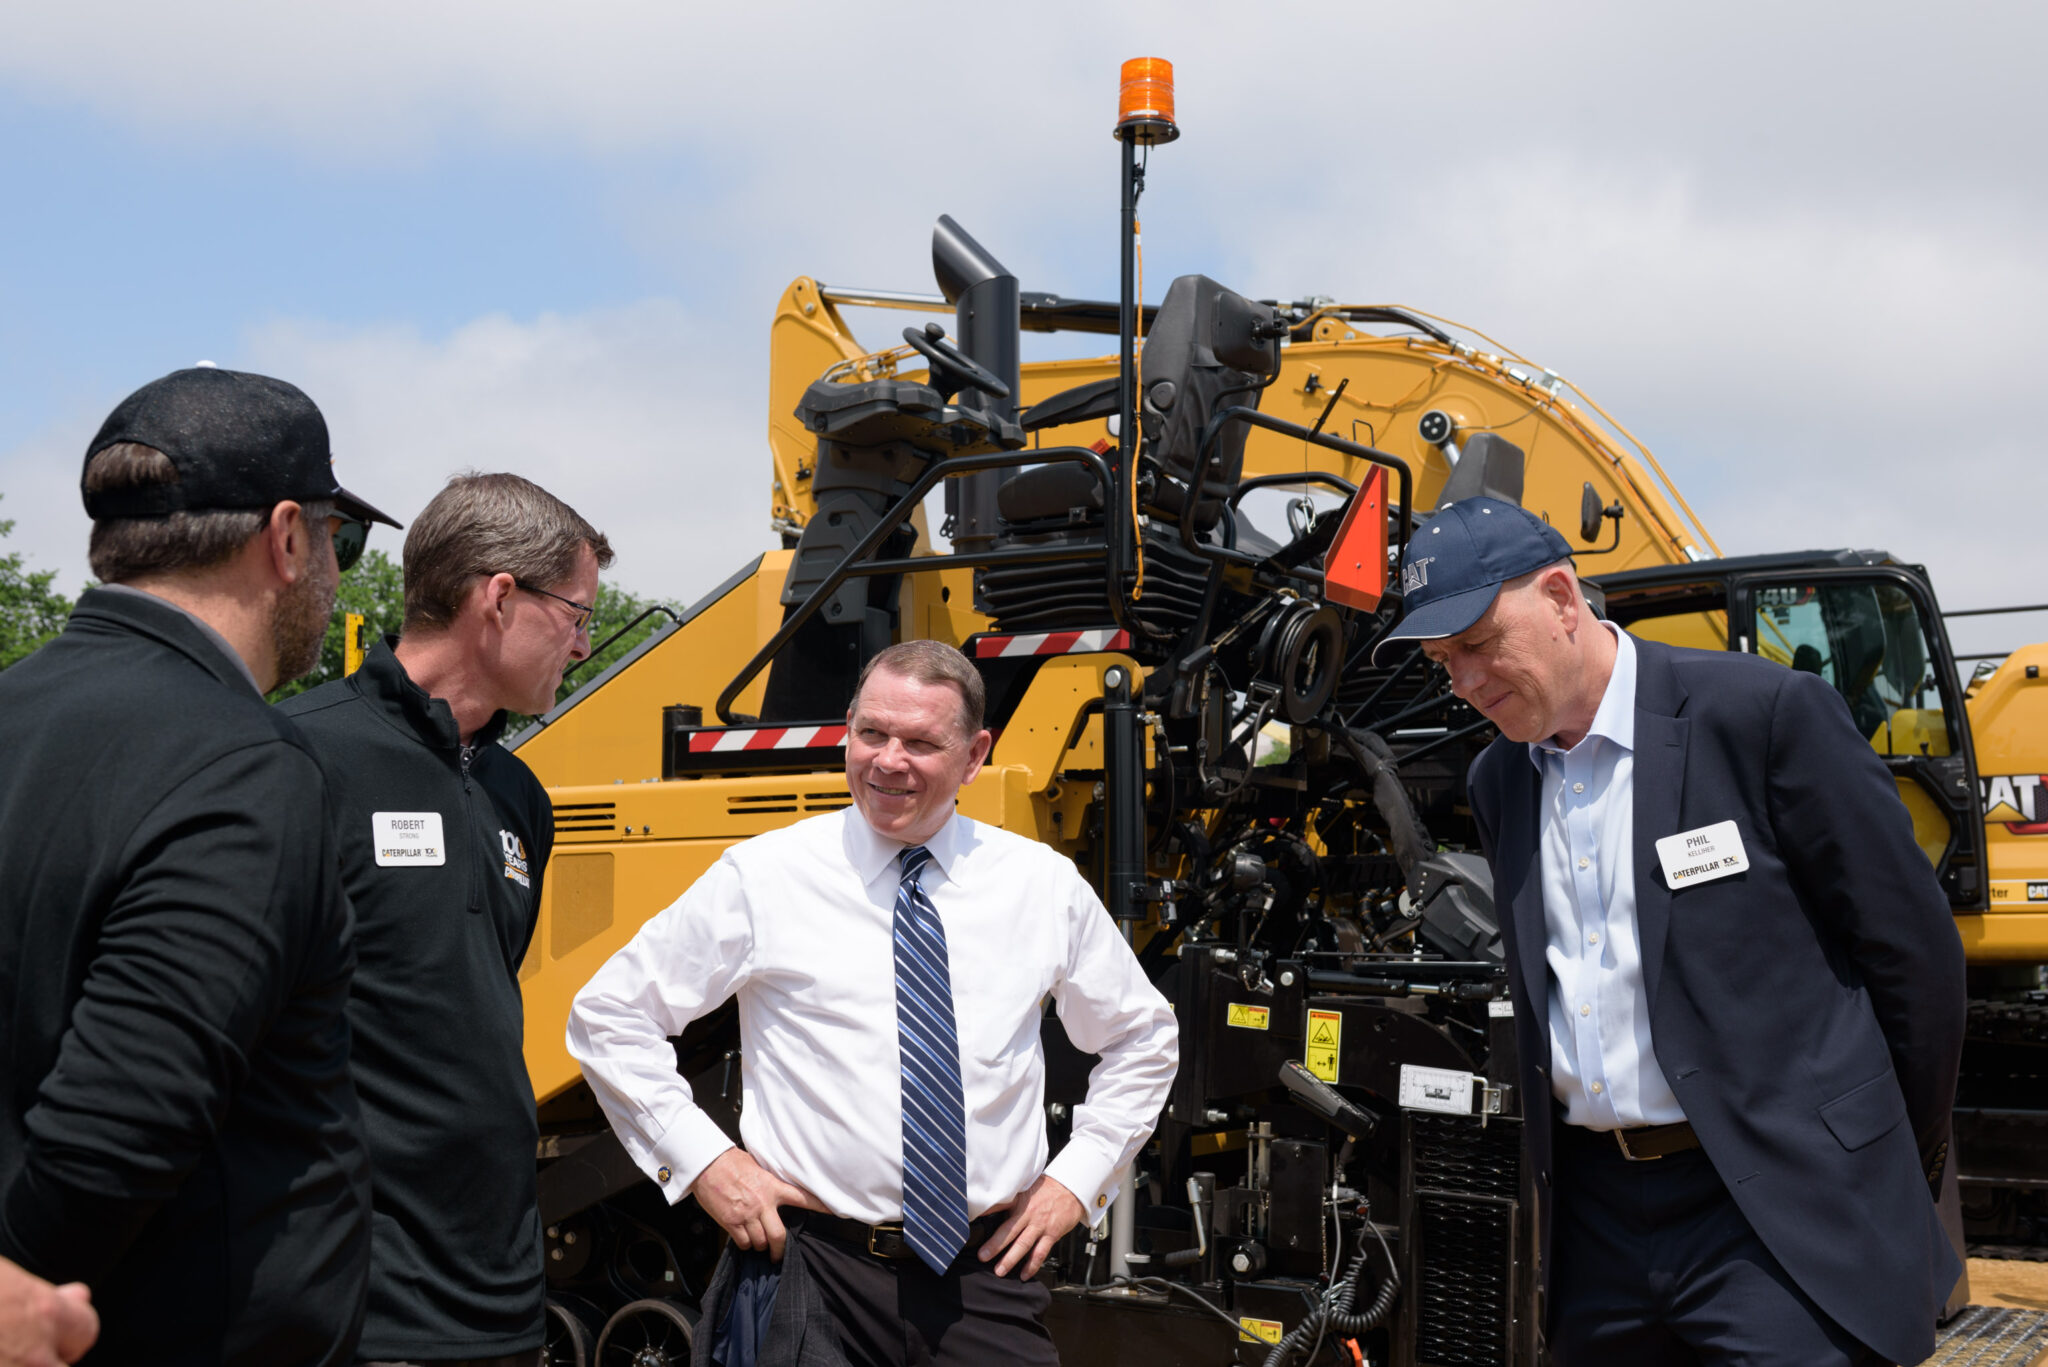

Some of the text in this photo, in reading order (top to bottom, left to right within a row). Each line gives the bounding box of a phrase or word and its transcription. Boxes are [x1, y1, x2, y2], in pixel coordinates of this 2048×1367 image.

[1402, 557, 1429, 597] CAT
[1979, 774, 2041, 822] AT
[391, 819, 425, 830] ROBERT
[498, 829, 527, 860] 100
[1686, 834, 1711, 849] PHIL
[382, 849, 422, 857] CATERPILLAR
[503, 849, 528, 873] YEARS
[1672, 860, 1720, 880] CATERPILLAR
